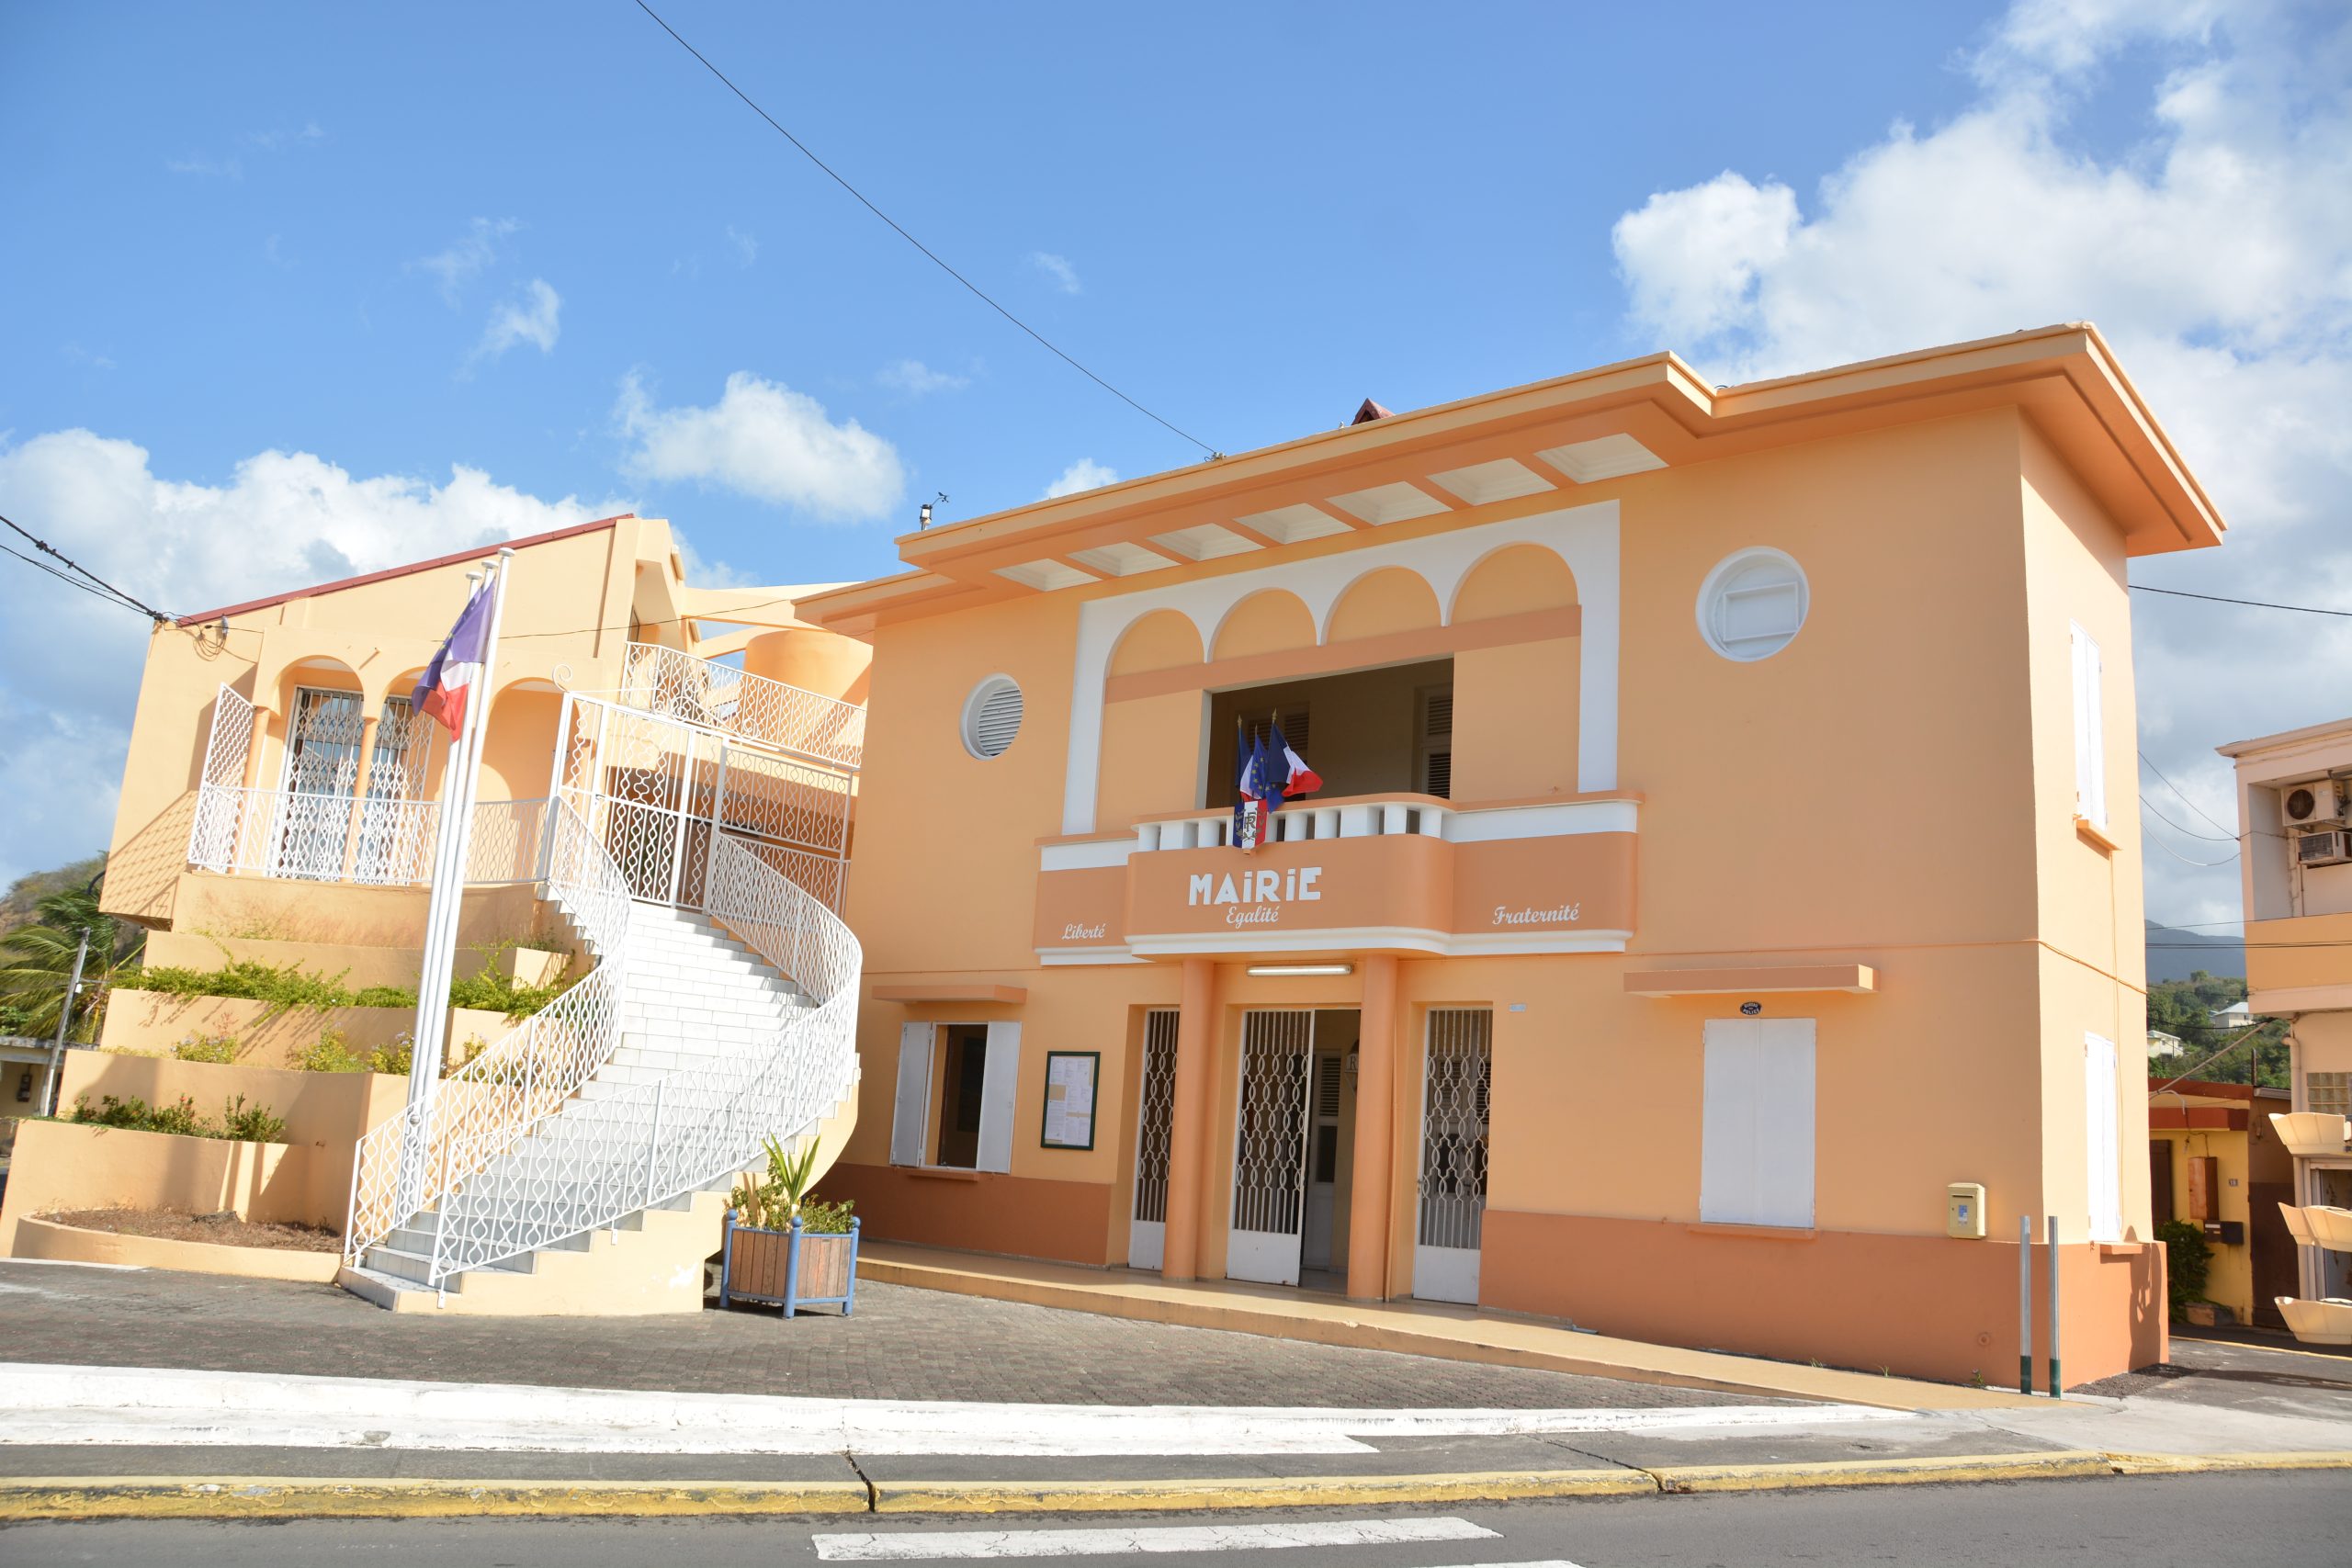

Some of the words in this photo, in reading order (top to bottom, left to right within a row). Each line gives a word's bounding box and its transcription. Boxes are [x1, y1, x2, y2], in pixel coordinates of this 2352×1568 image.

[1226, 905, 1280, 930] Egalité
[1491, 902, 1580, 925] Fraternité
[1061, 923, 1107, 940] Liberté
